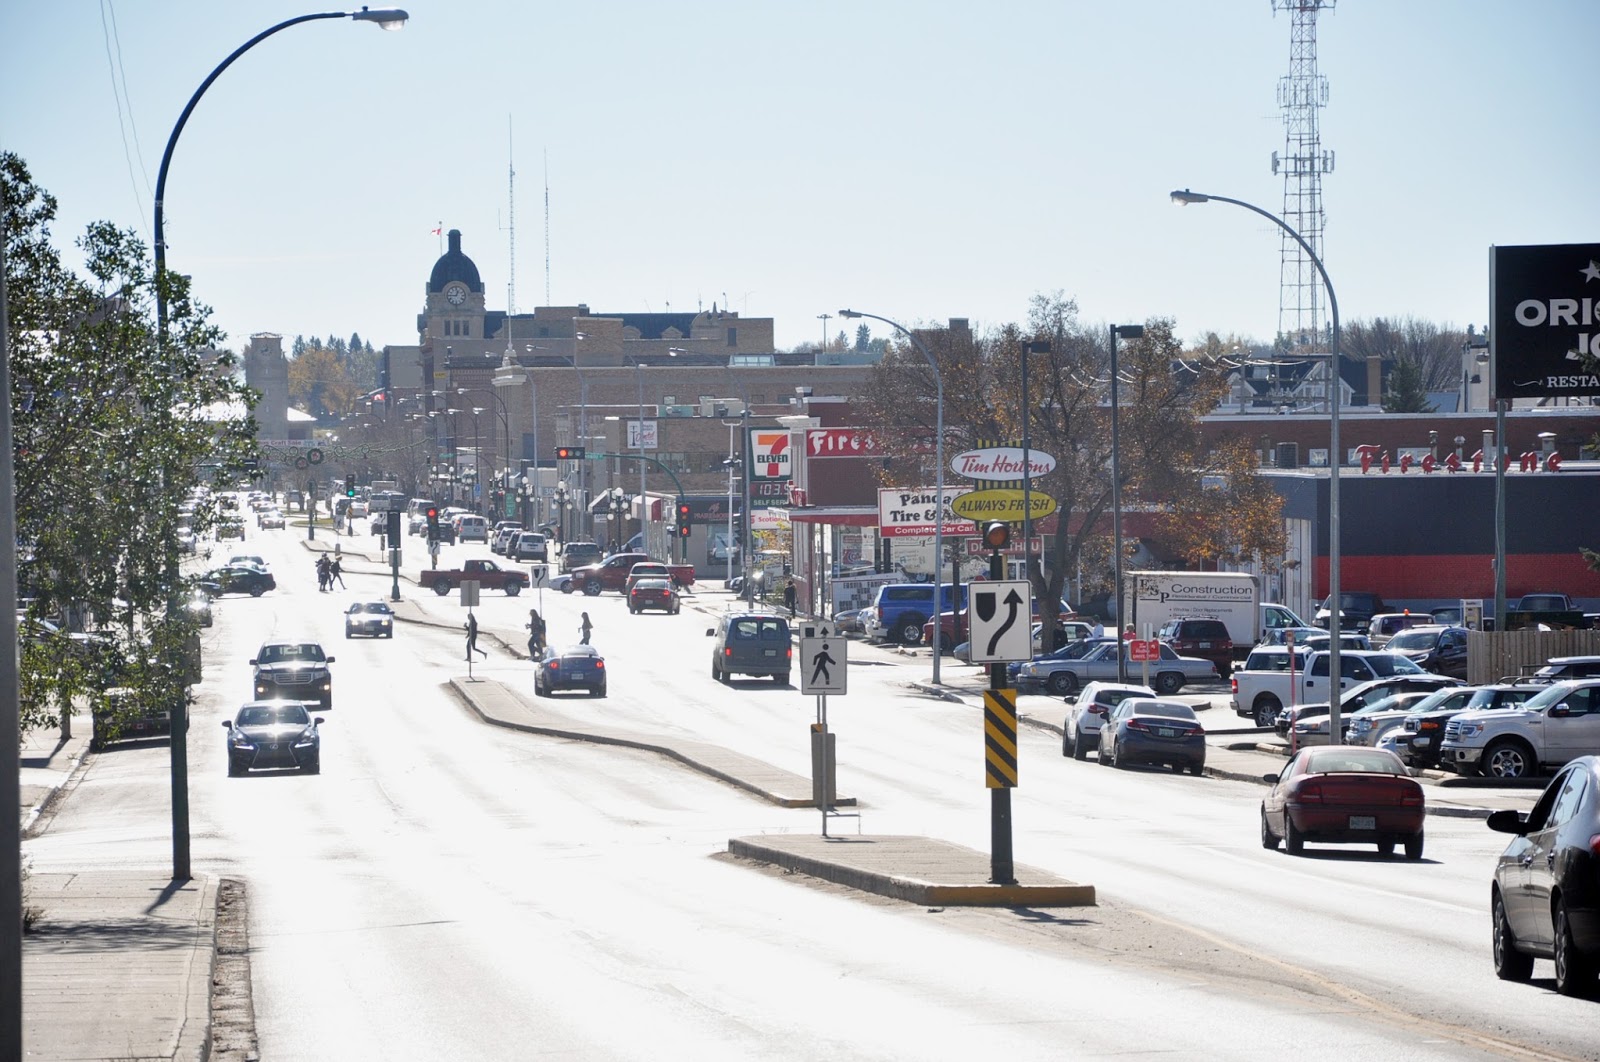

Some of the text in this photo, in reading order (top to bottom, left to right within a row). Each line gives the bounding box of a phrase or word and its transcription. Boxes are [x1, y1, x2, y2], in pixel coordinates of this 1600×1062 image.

[1515, 298, 1600, 327] ORI
[961, 454, 1050, 473] Tim Hortons
[958, 500, 1006, 511] ALWAYS
[889, 510, 920, 522] Tire
[940, 525, 955, 533] Car
[957, 524, 976, 532] Car
[1171, 584, 1252, 594] Construction
